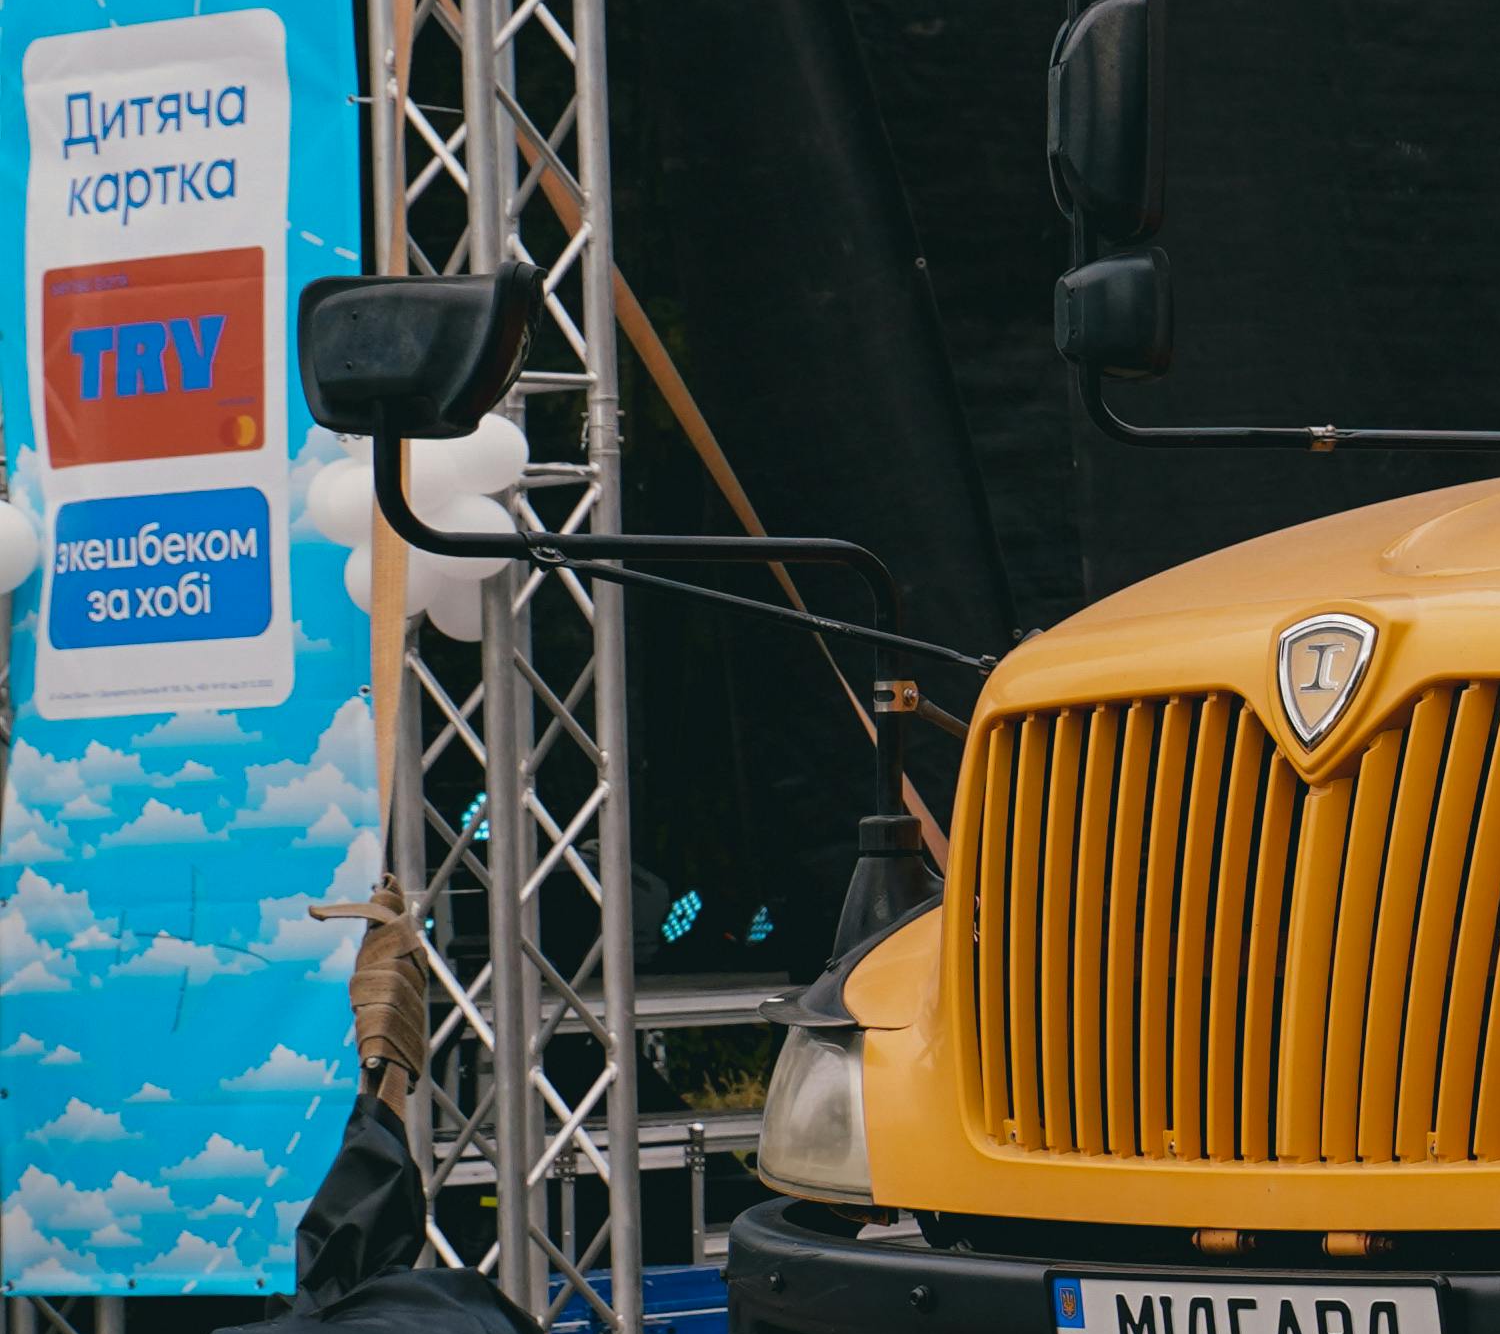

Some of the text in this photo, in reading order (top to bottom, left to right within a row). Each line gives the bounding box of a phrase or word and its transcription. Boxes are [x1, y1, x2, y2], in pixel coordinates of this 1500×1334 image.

[63, 85, 246, 160] Дитяча
[67, 159, 236, 226] картка
[70, 314, 227, 401] TRY
[86, 571, 212, 622] за хобі
